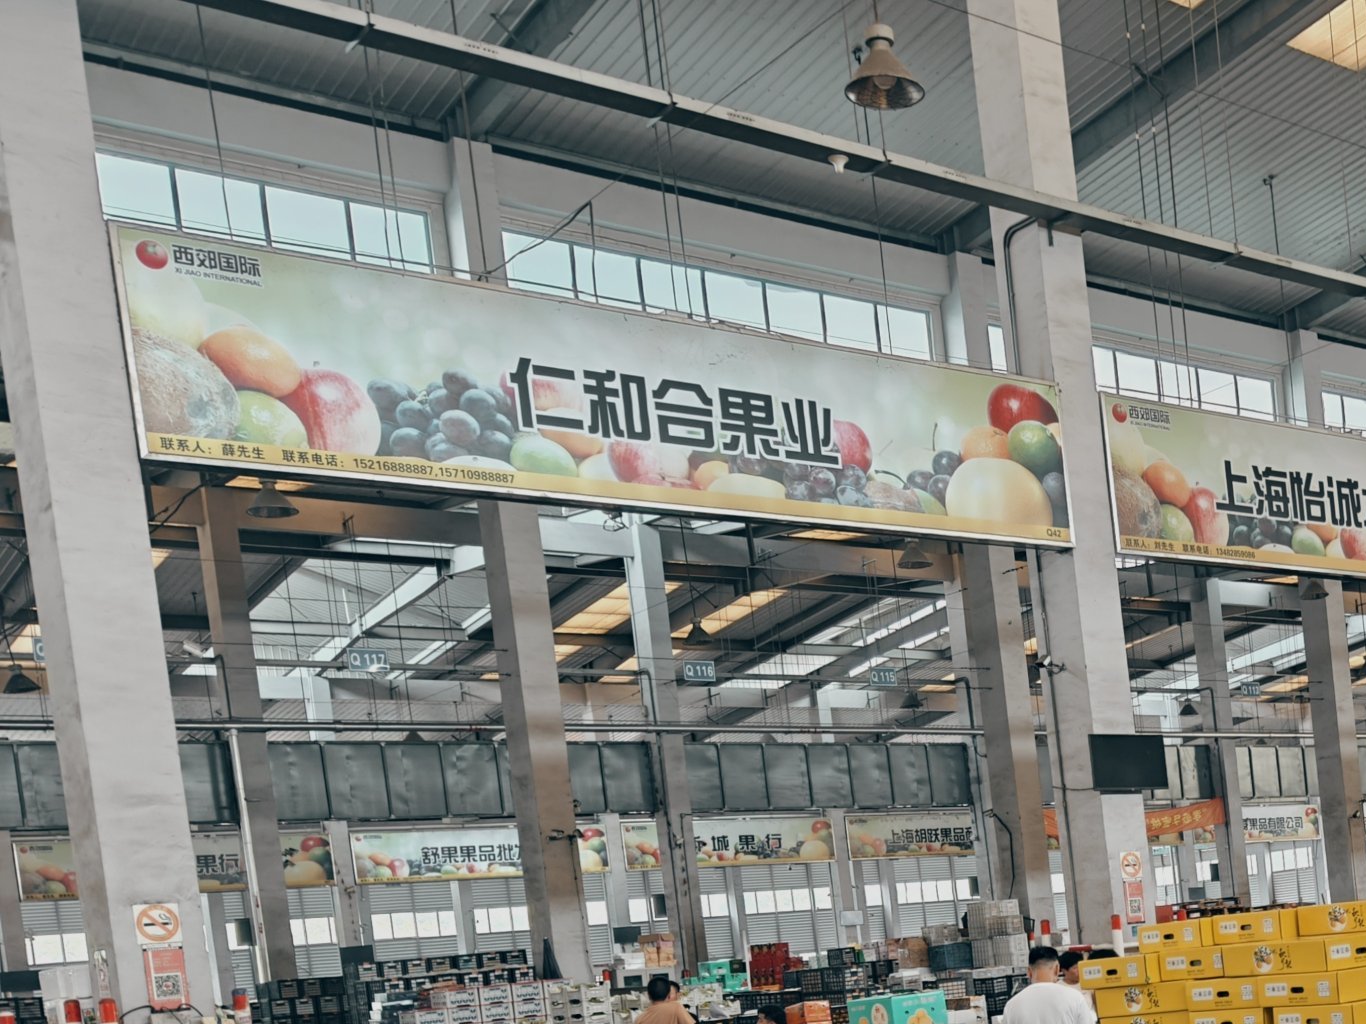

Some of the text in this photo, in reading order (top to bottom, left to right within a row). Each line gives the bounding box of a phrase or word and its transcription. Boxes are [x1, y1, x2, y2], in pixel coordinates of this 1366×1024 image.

[171, 243, 262, 278] 西郊国际
[203, 270, 263, 287] INTERNATIONAL
[509, 357, 840, 466] 仁和合果业
[1128, 404, 1171, 424] 西郊国际
[221, 442, 266, 461] 薛先生
[282, 448, 345, 468] 联系电话：
[1045, 527, 1061, 537] Q42
[685, 664, 714, 677] Q116
[196, 853, 240, 873] 果行
[421, 843, 521, 866] 舒果果品批
